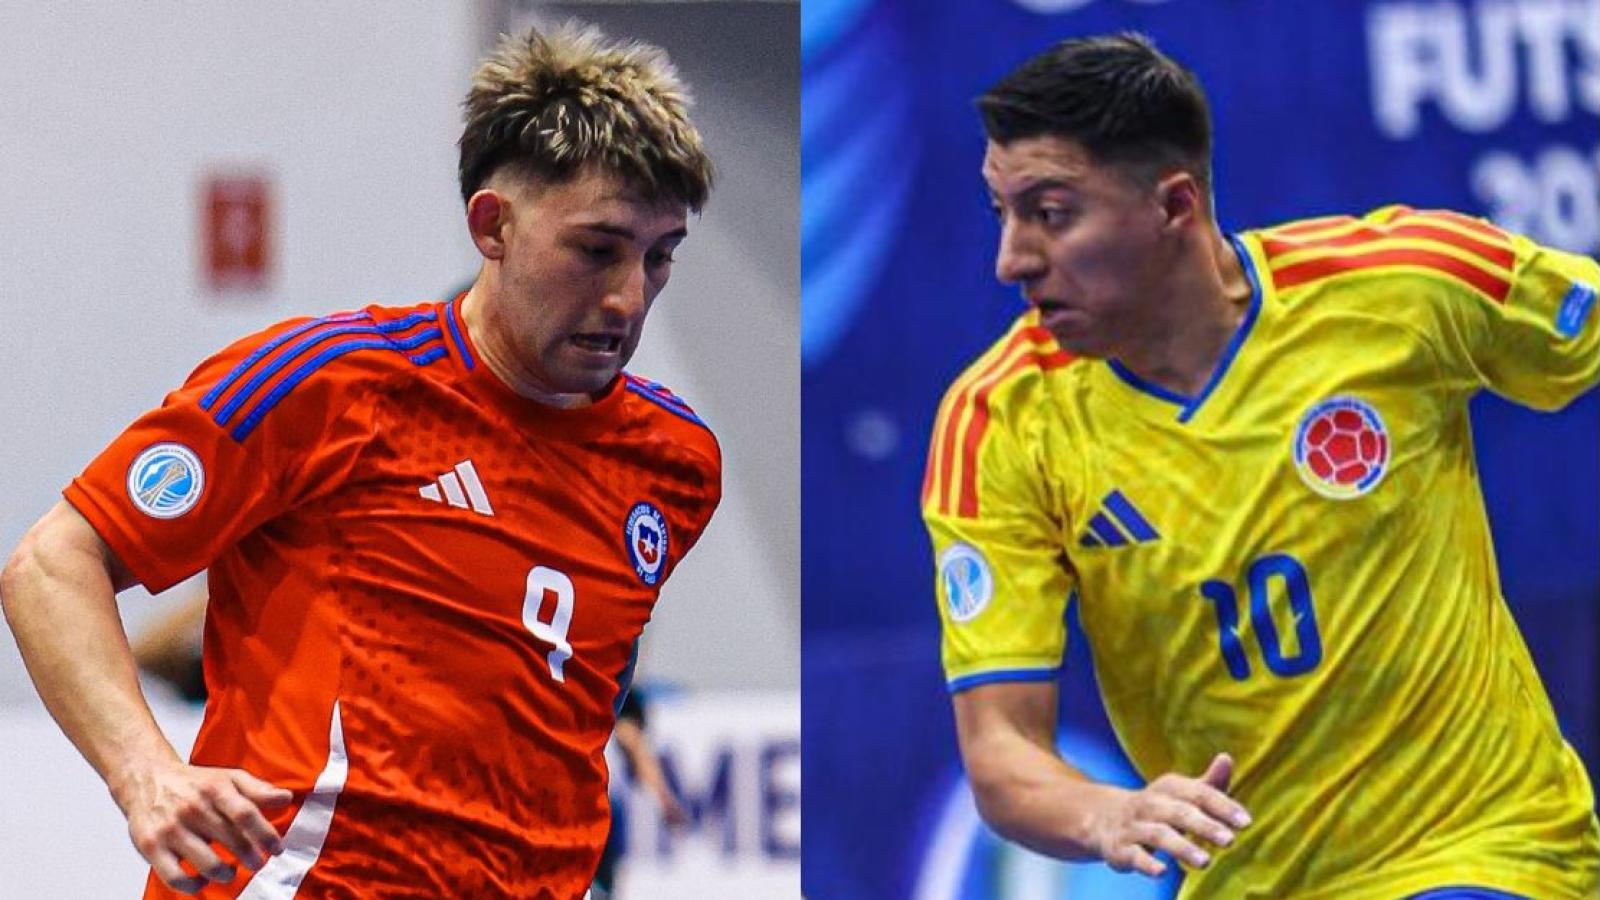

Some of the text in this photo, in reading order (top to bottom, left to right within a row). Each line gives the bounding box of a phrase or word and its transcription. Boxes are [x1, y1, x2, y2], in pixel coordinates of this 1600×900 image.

[1472, 148, 1600, 252] 20
[522, 565, 574, 684] 9
[1200, 554, 1323, 681] 10
